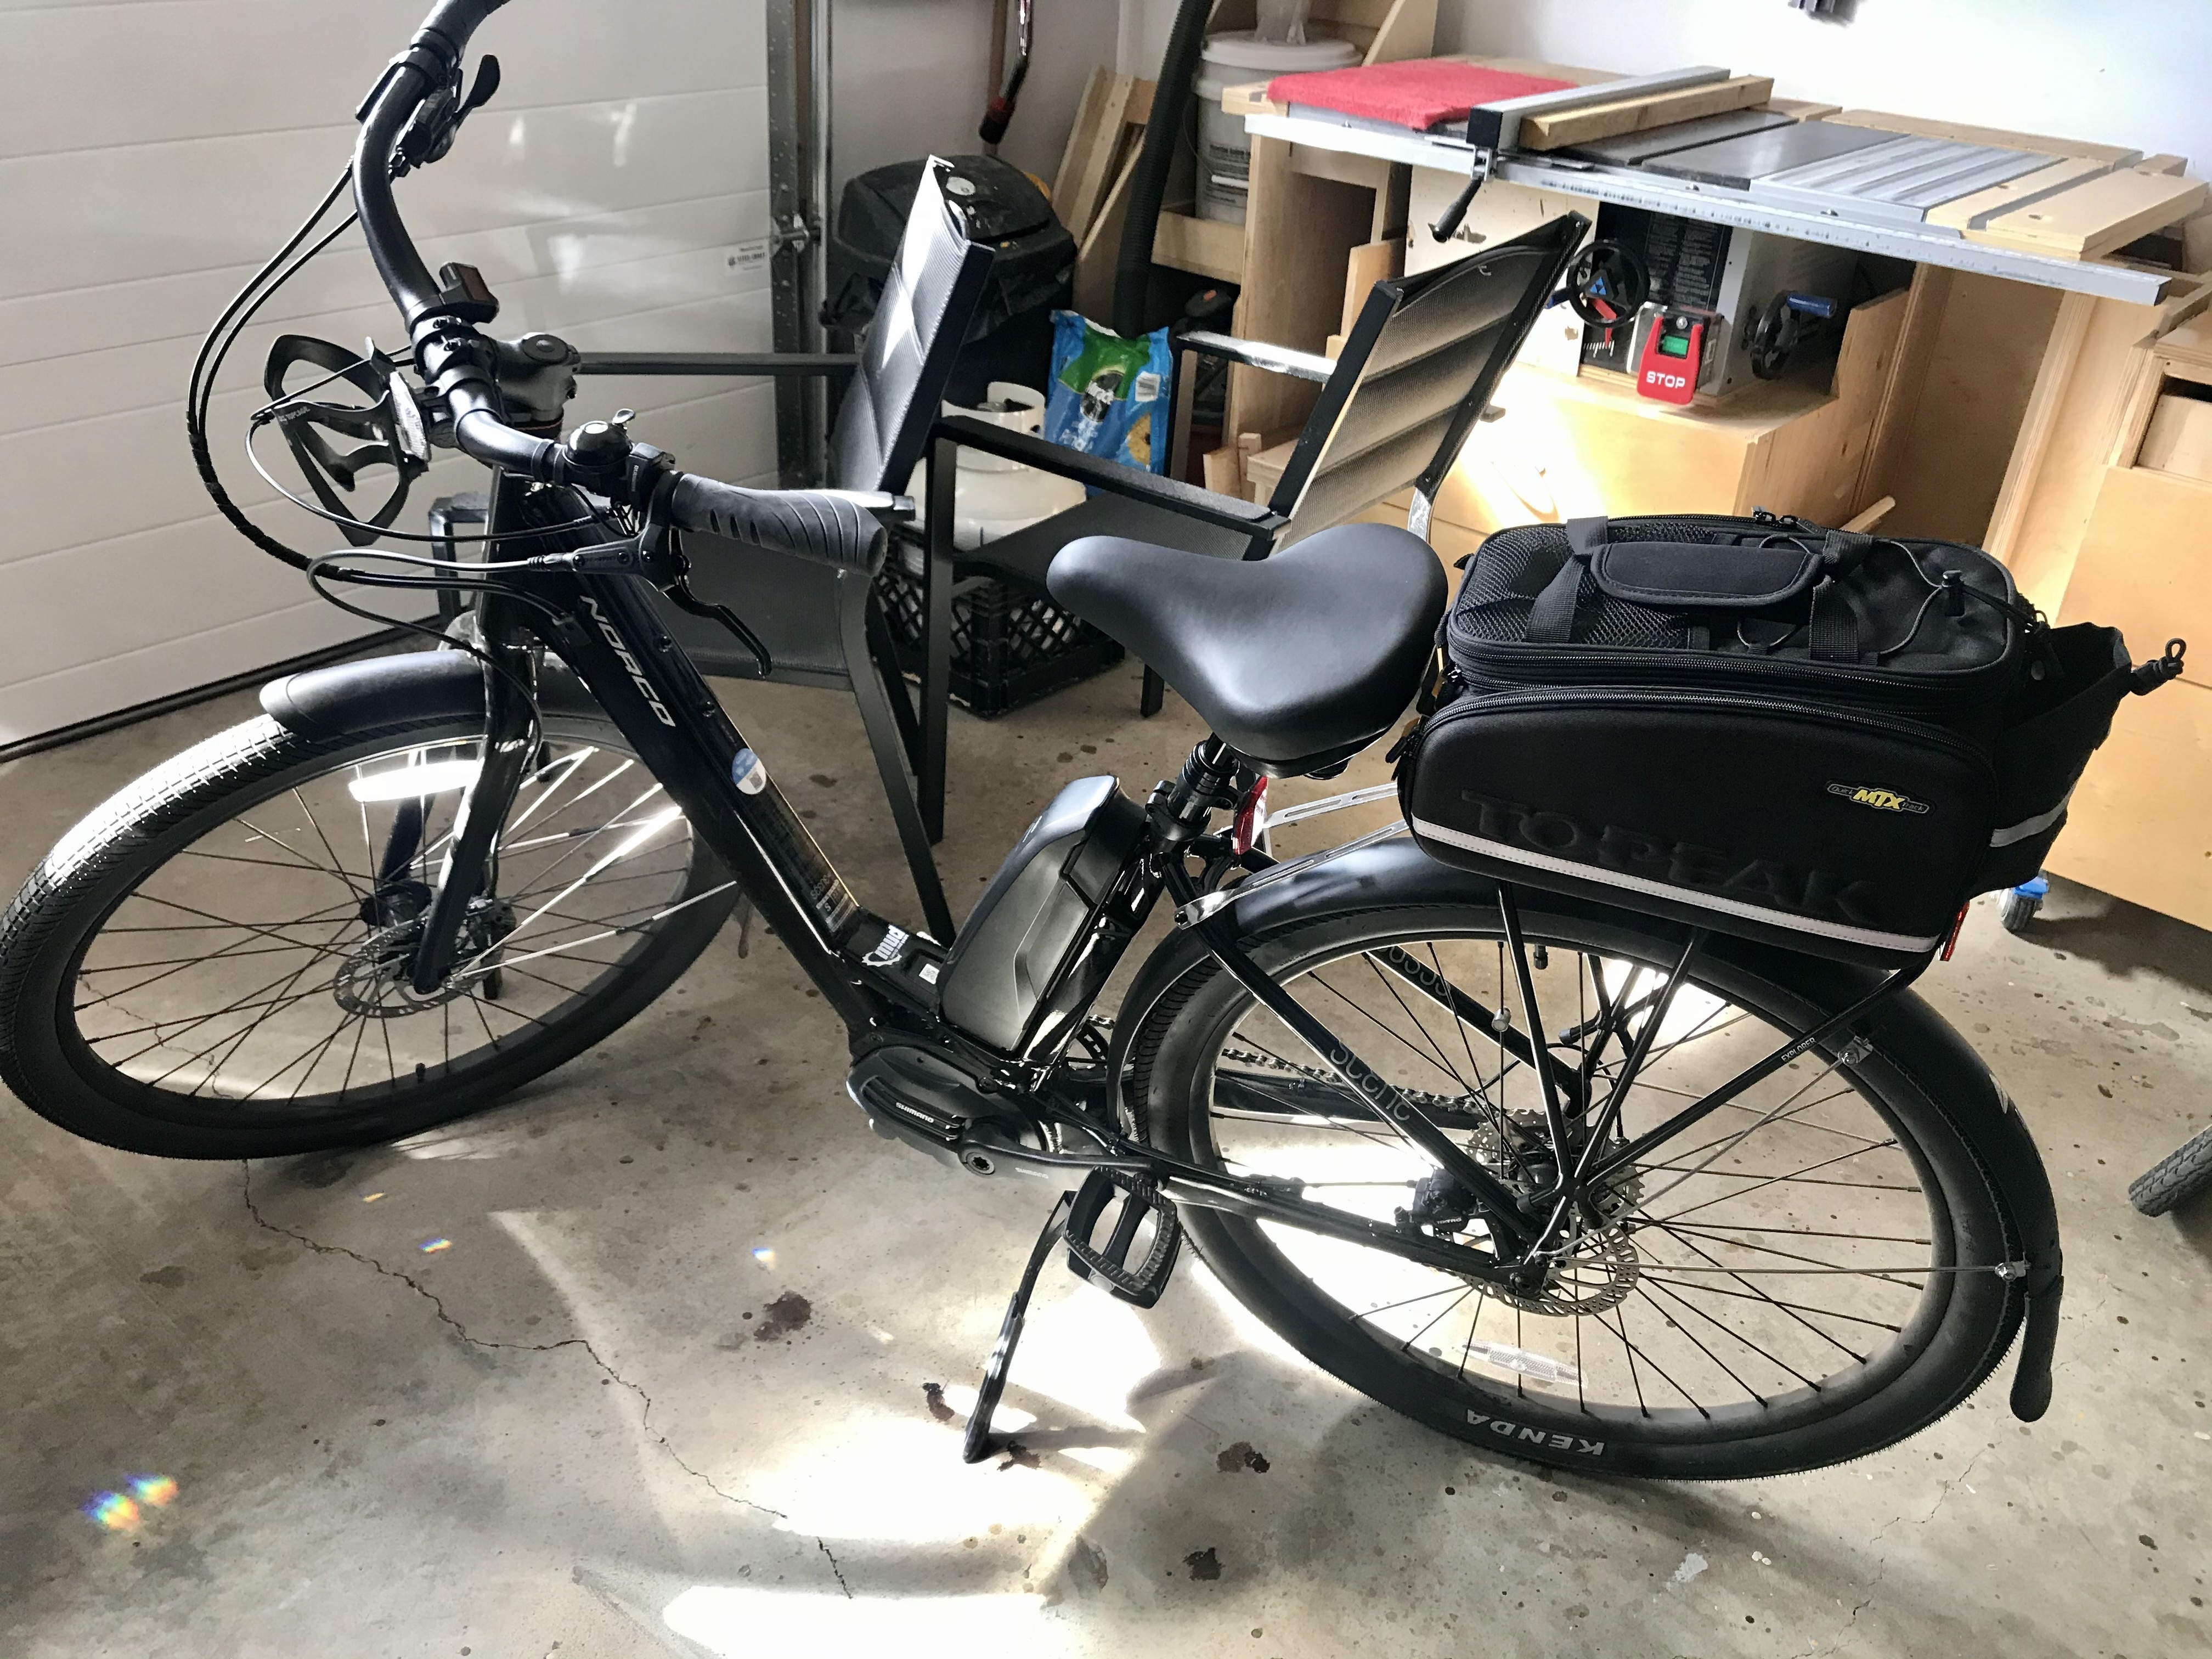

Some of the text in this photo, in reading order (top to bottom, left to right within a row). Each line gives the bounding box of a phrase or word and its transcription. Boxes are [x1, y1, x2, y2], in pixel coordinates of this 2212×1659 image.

[1646, 370, 1685, 388] STOP
[579, 595, 676, 727] NORCO
[1831, 786, 1925, 811] Quick MTX Track
[1461, 789, 1891, 924] TOPEAK
[875, 924, 905, 960] mud
[1781, 1037, 1817, 1062] EXPLORER
[895, 1102, 934, 1124] SHIMANO
[1015, 1167, 1049, 1180] SHIMANO
[1467, 1409, 1605, 1455] KENDA
